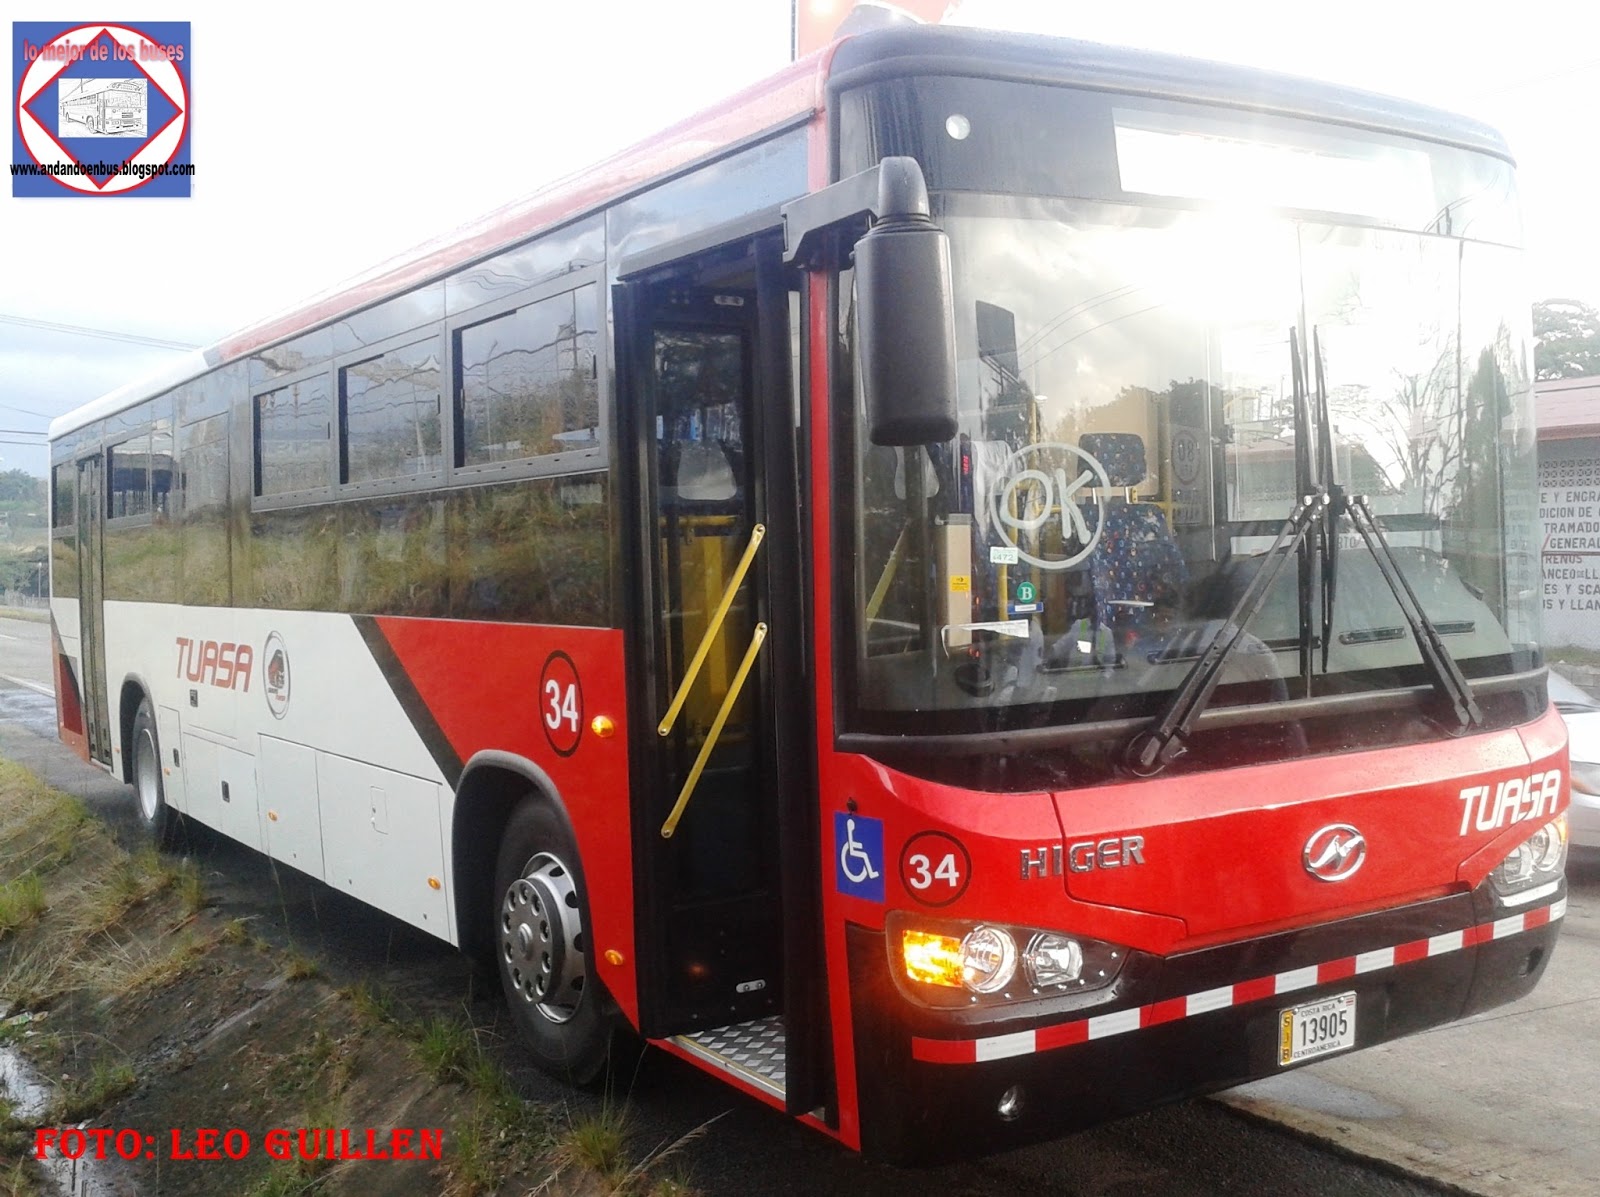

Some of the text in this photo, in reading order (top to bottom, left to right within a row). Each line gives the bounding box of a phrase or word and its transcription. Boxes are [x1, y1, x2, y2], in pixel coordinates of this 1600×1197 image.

[1000, 468, 1093, 545] OK
[1553, 491, 1560, 503] Y
[1578, 506, 1592, 517] DE
[1020, 586, 1033, 600] B
[1544, 583, 1558, 595] ES
[1565, 583, 1572, 595] Y
[1558, 599, 1565, 610] Y
[176, 637, 254, 693] TUASA
[545, 679, 578, 732] 34
[1459, 769, 1561, 837] TUASA
[909, 853, 960, 890] 34
[1020, 835, 1145, 880] HIGER
[1300, 1009, 1348, 1047] 13905
[1301, 1003, 1336, 1018] COSTA RICA
